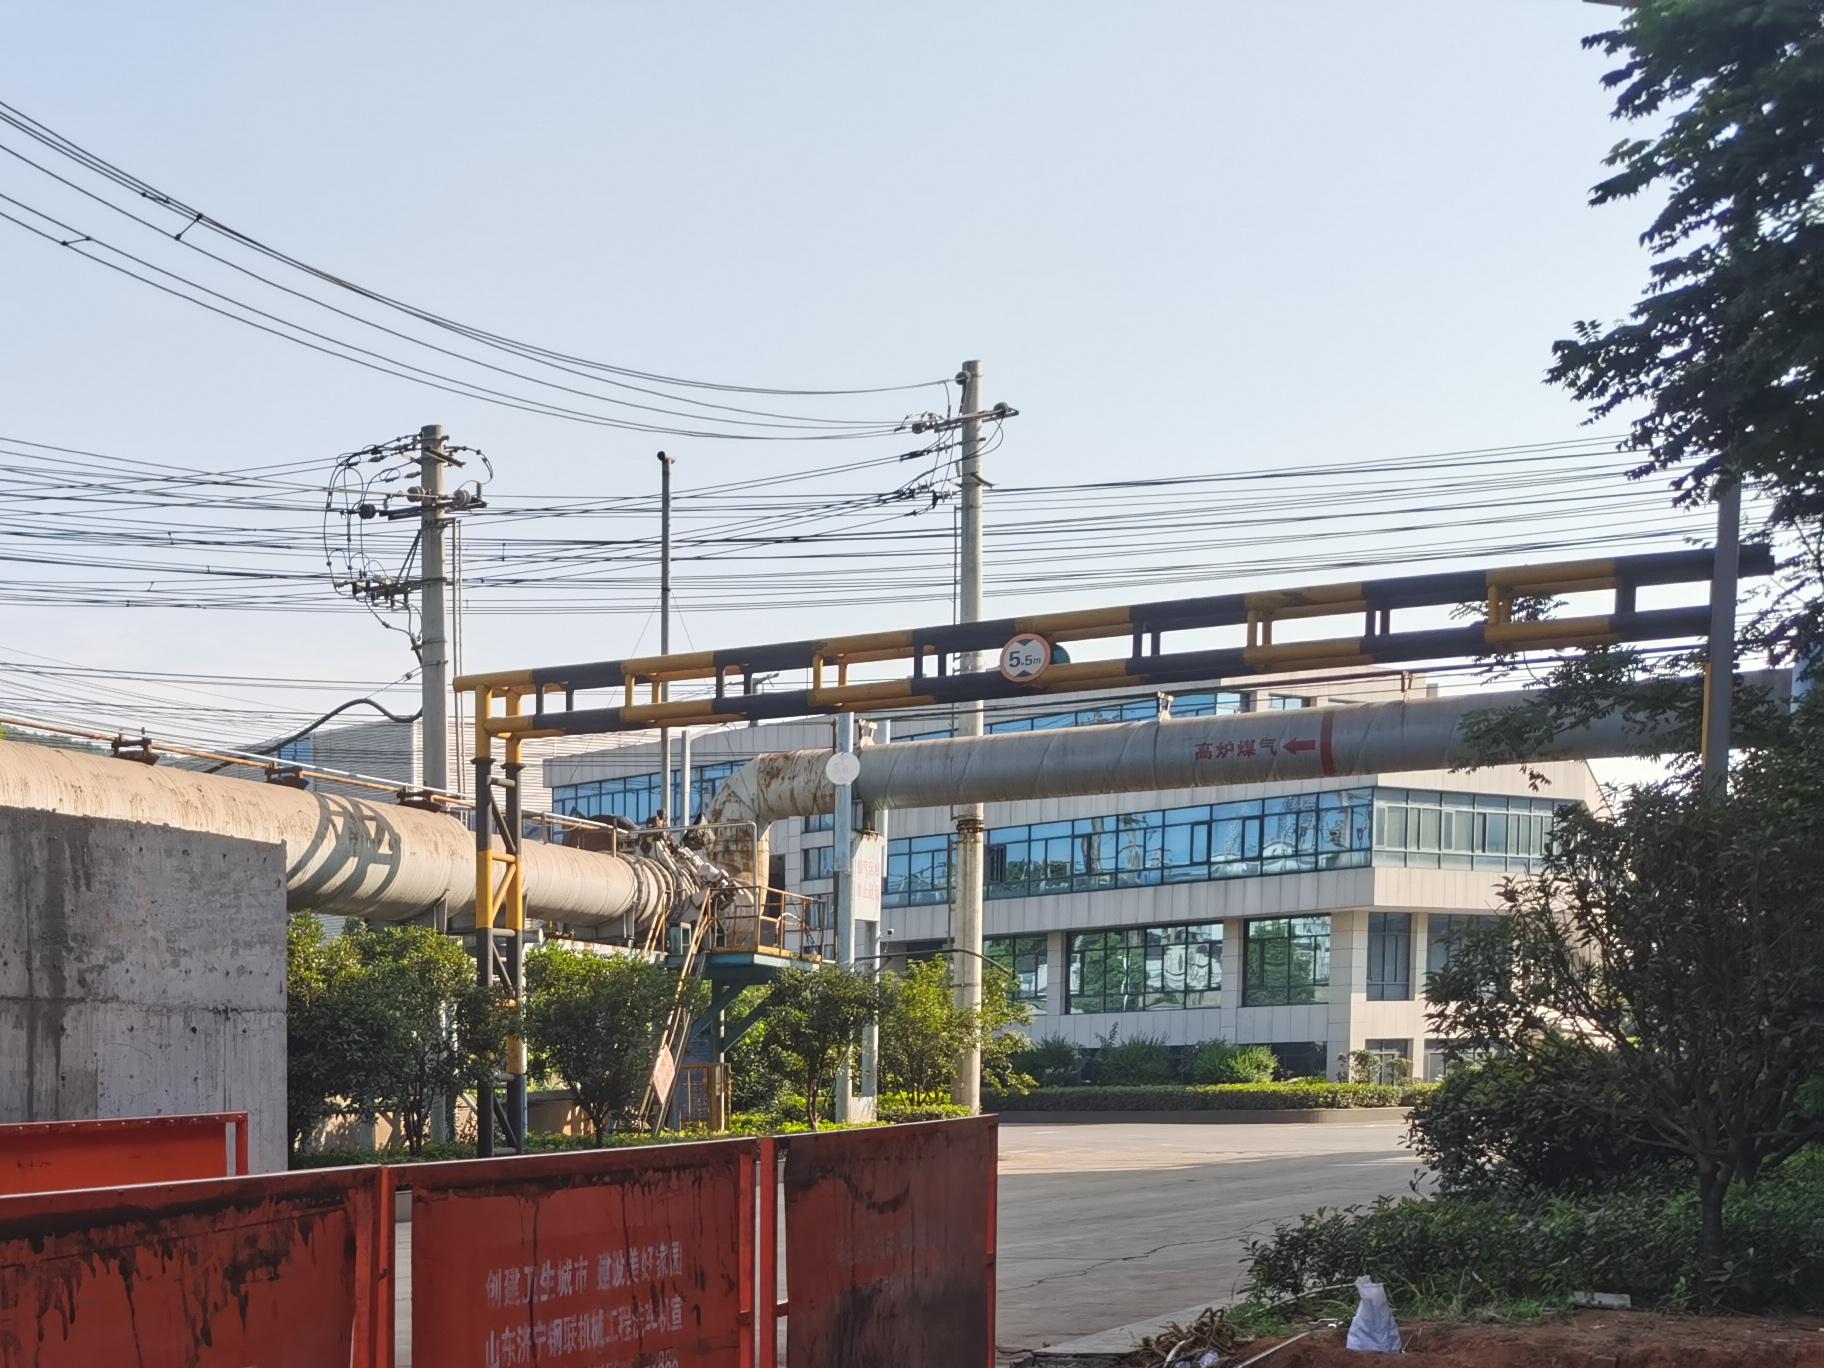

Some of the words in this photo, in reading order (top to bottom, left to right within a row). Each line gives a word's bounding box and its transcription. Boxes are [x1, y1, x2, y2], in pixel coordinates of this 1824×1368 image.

[1008, 650, 1042, 668] 5.5m
[1194, 738, 1278, 761] 高炉煤气
